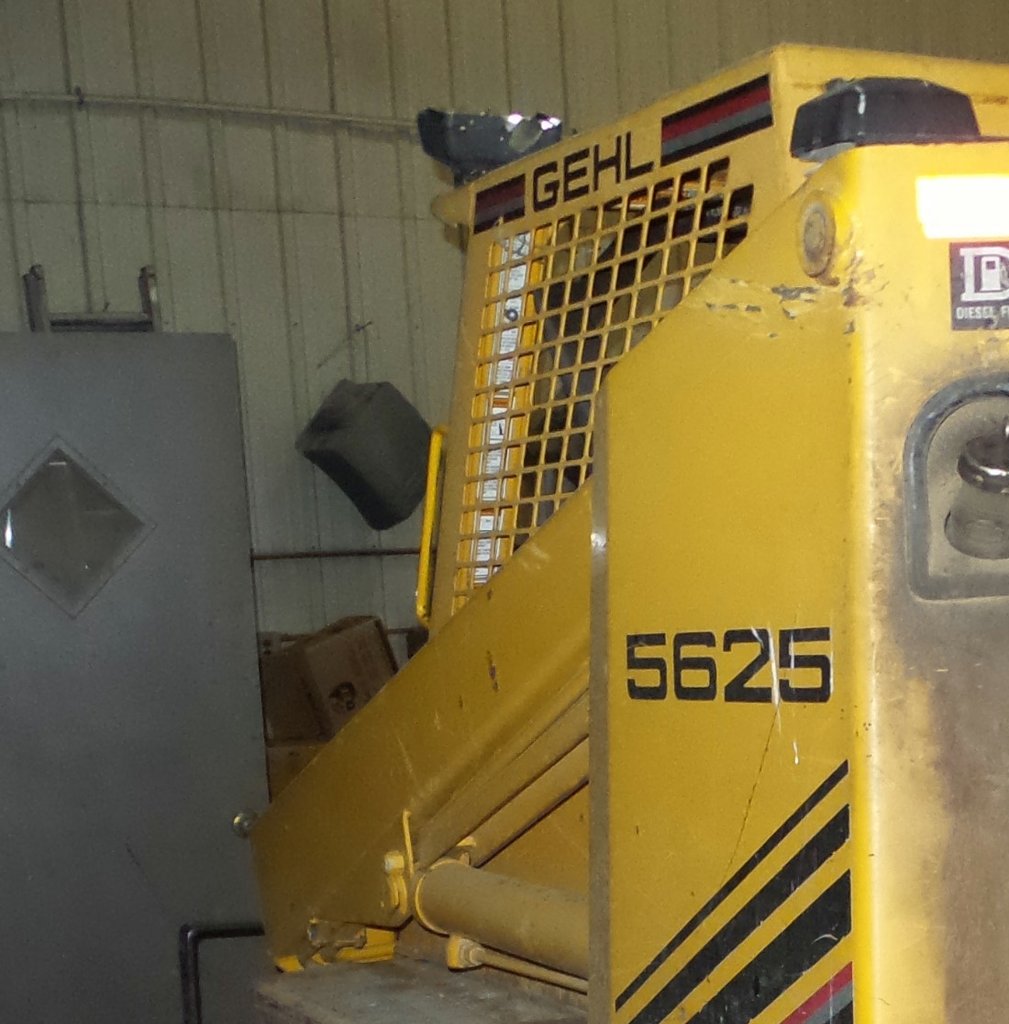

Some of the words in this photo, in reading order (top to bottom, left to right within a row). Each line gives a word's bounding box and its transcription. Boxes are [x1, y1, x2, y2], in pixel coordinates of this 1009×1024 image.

[533, 131, 655, 213] GEHL
[956, 305, 996, 319] DIESEL
[626, 626, 831, 703] 5625
